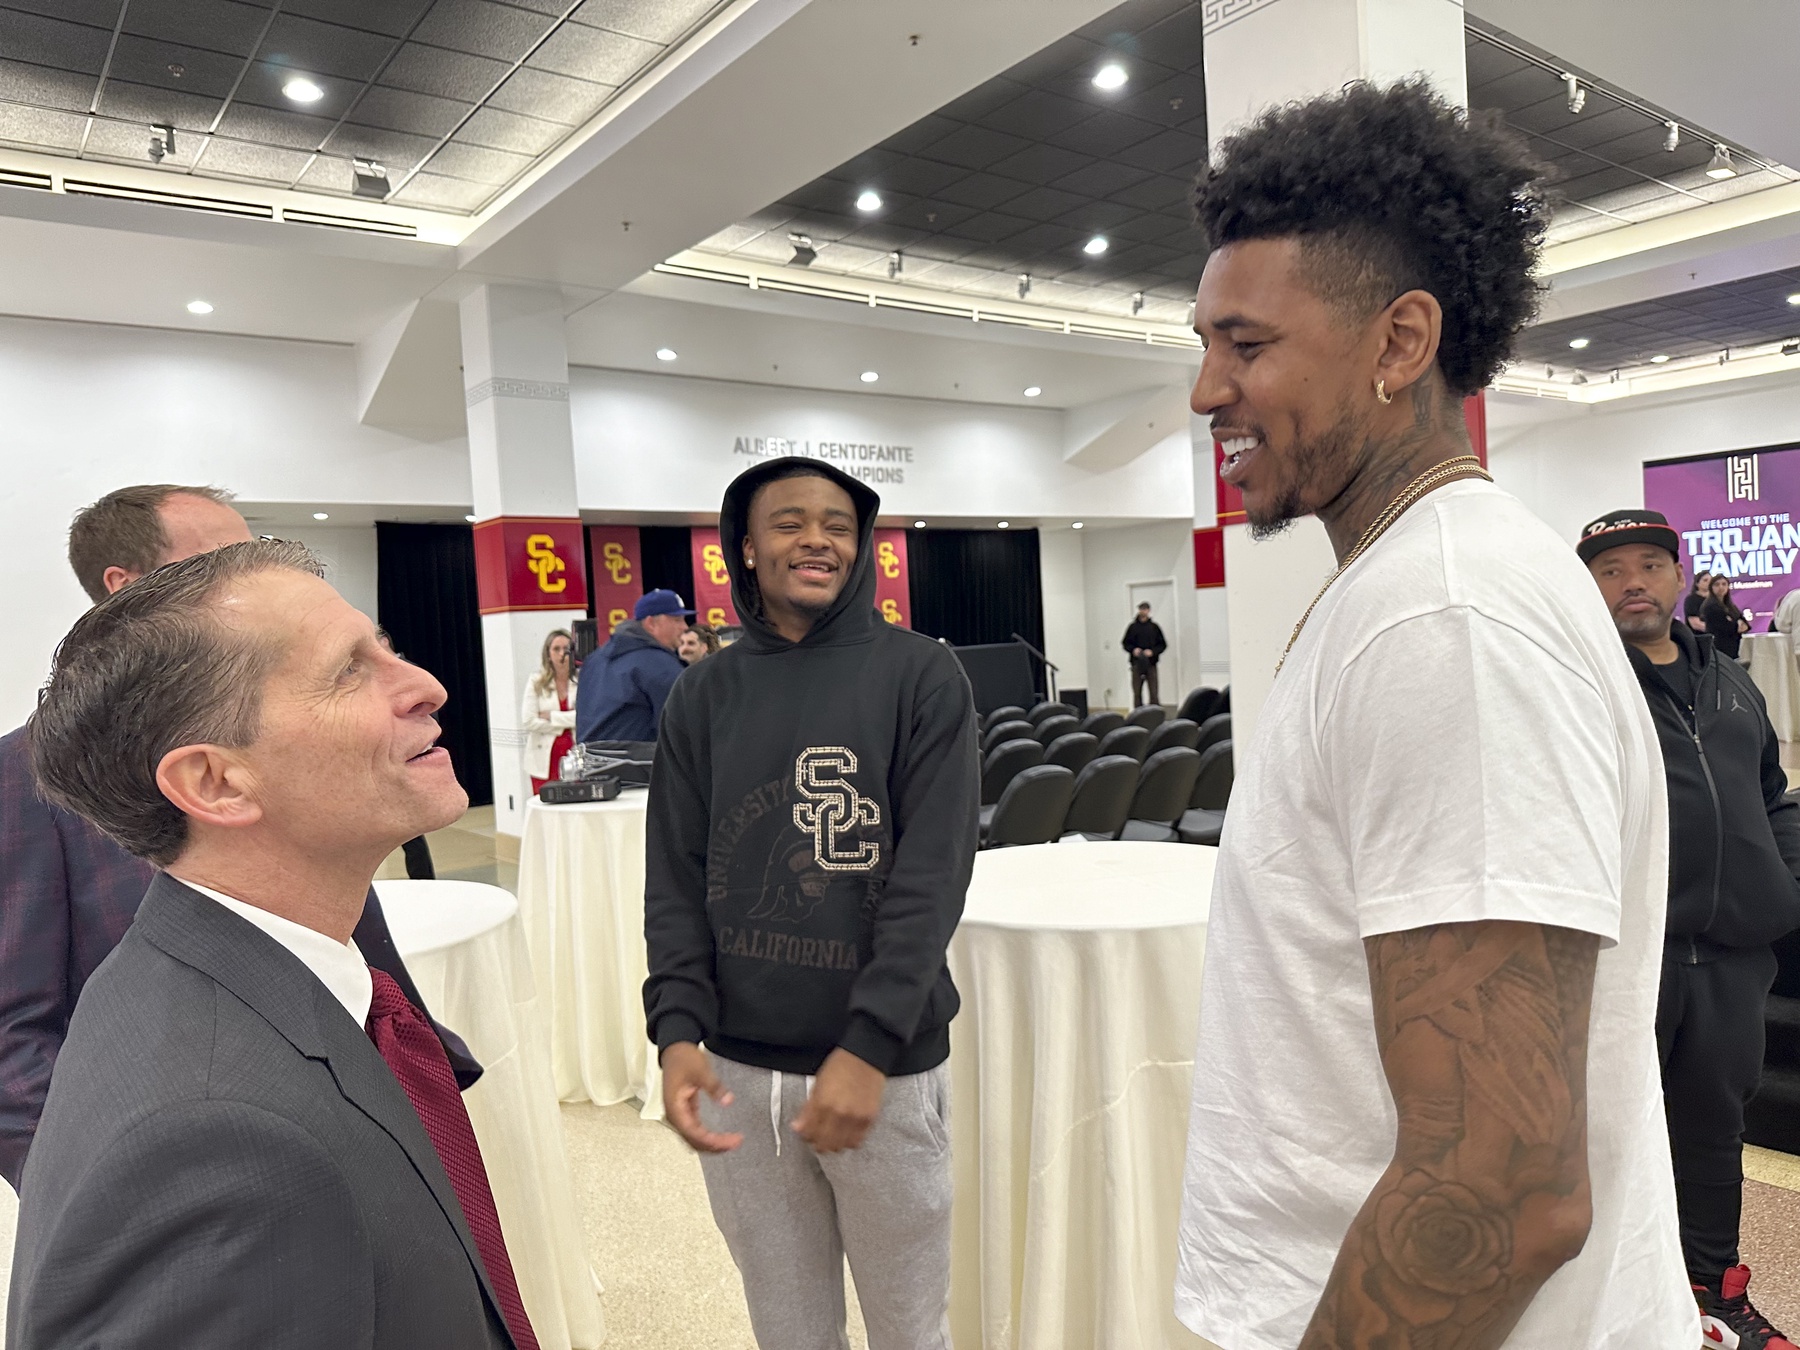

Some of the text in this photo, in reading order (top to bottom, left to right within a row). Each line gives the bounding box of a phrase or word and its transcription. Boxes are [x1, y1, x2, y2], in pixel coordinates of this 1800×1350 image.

[733, 436, 797, 457] ALBERT
[819, 442, 914, 463] CENTOFANTE
[1701, 513, 1790, 530] WELCOME TO THE
[1681, 522, 1800, 556] TROJAN
[526, 534, 566, 594] SC
[1693, 548, 1799, 579] FAMILY
[793, 746, 881, 870] SC
[717, 925, 859, 970] CALIFORNIA
